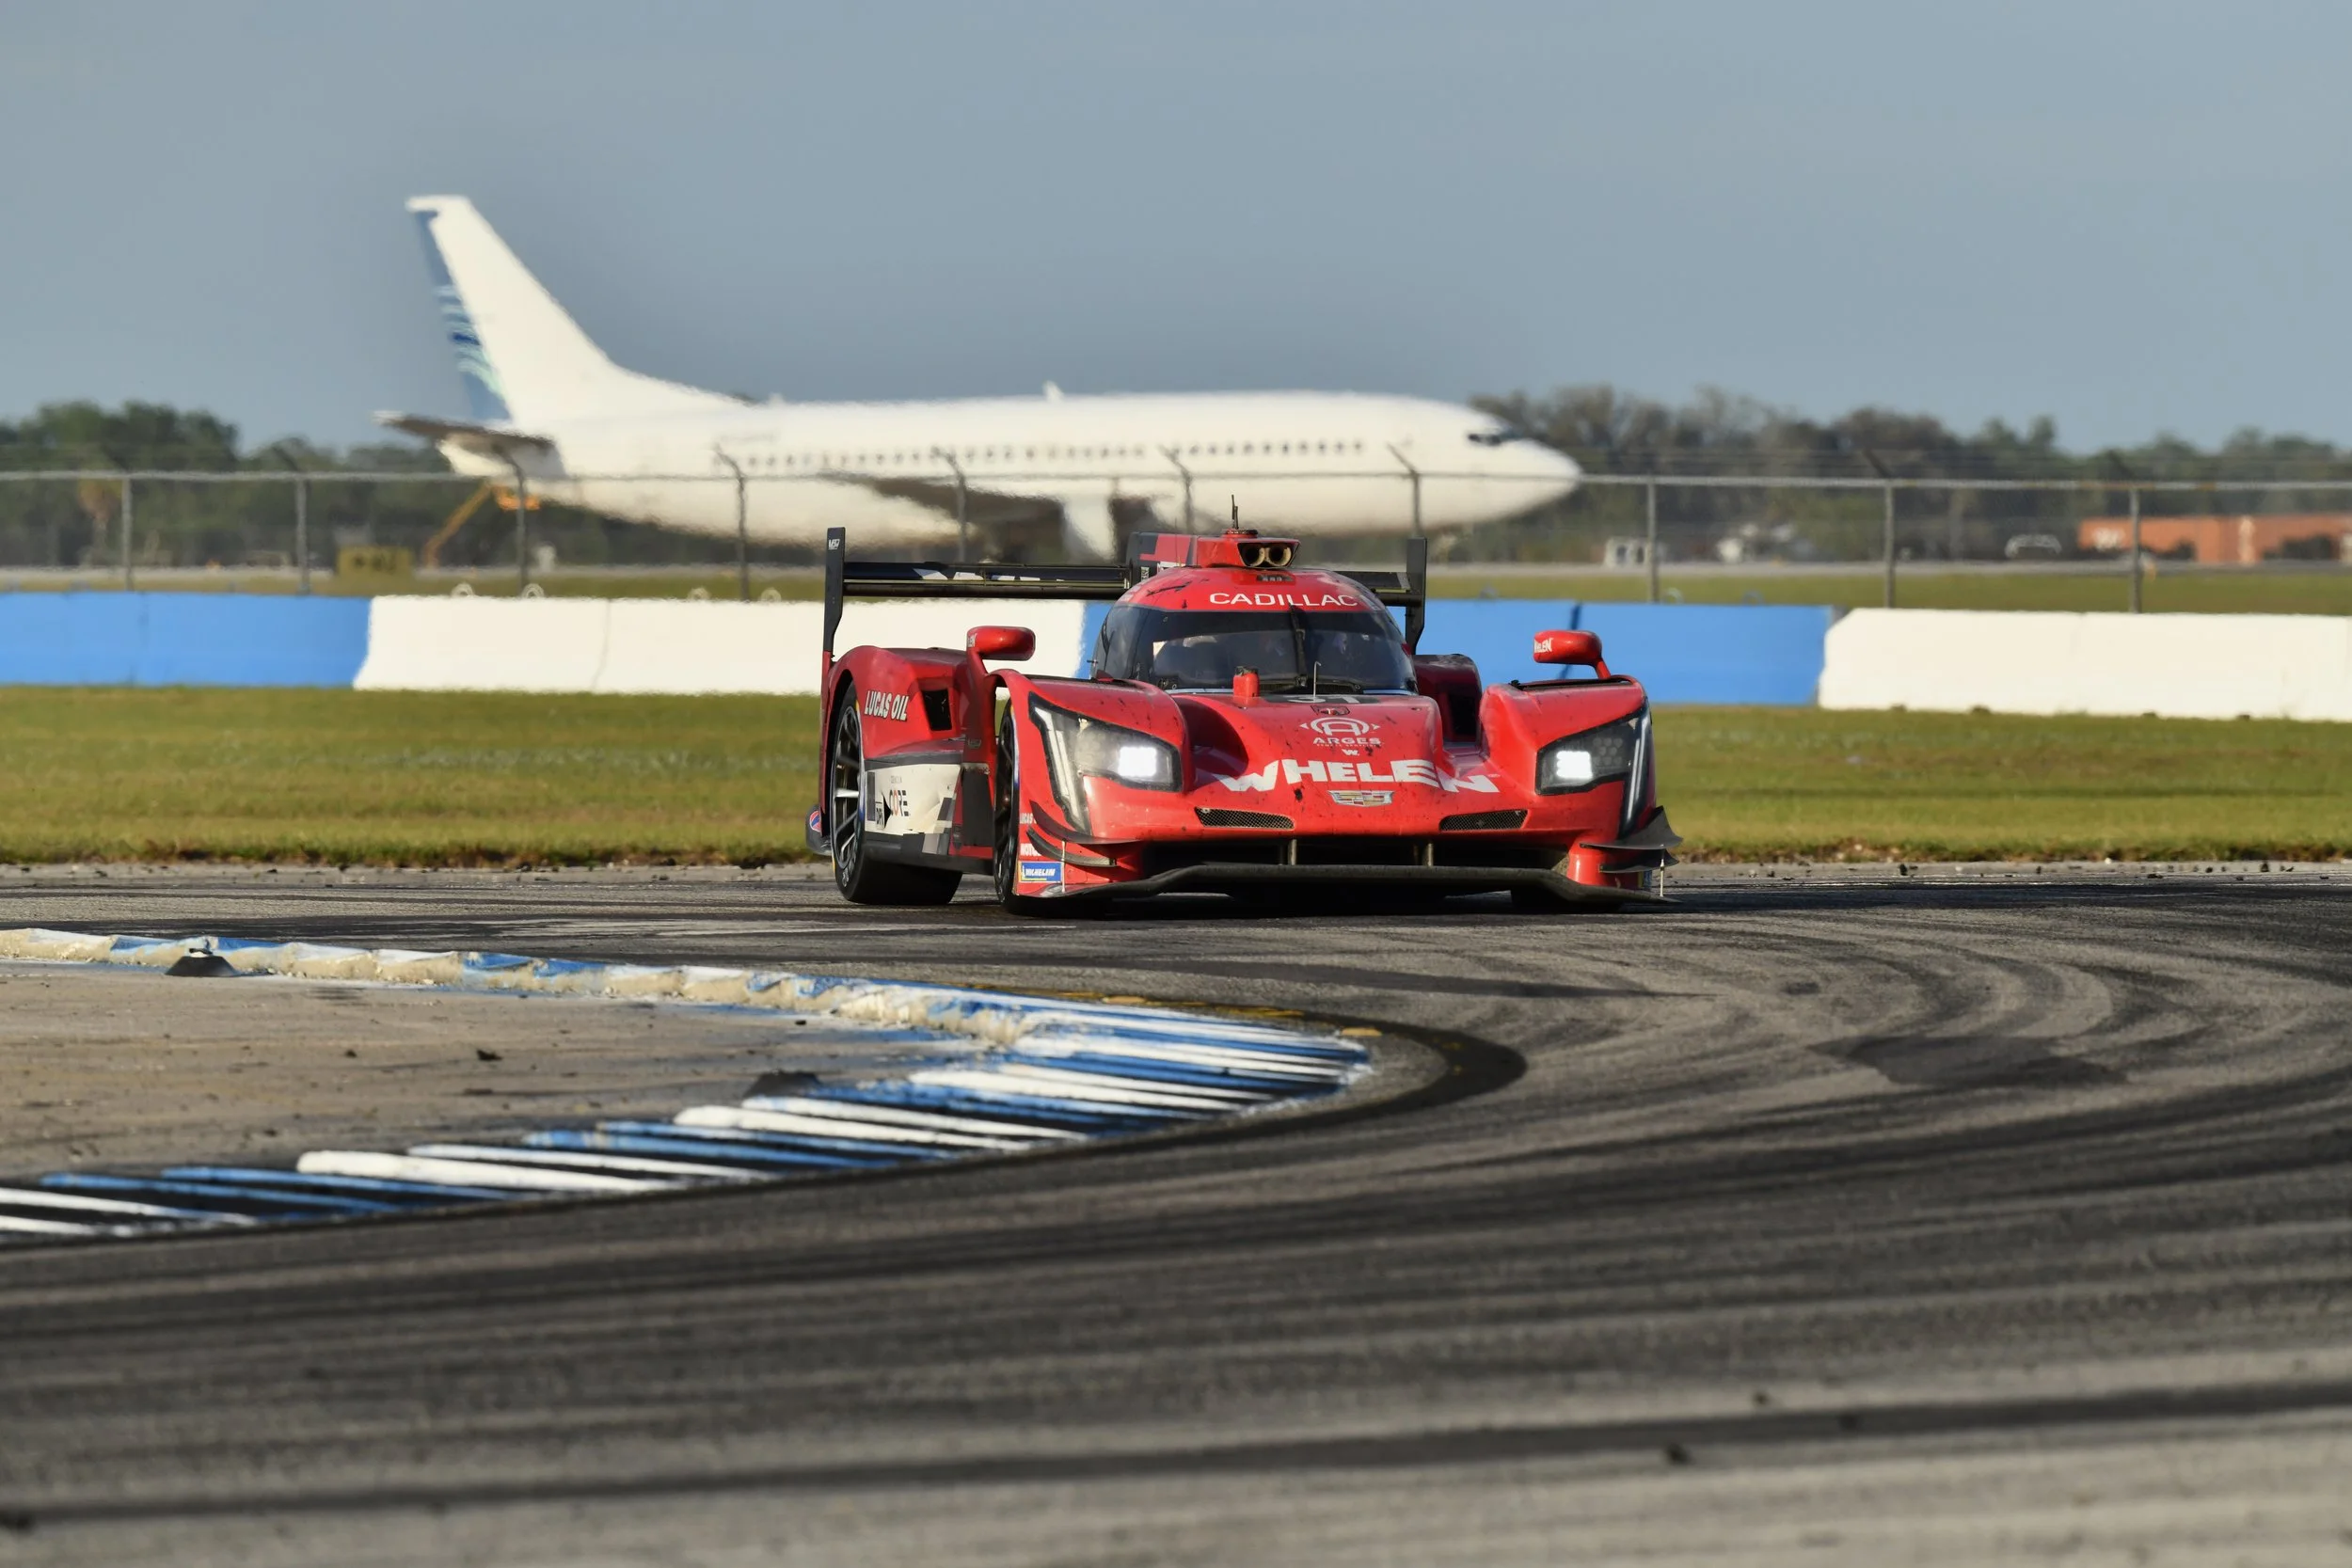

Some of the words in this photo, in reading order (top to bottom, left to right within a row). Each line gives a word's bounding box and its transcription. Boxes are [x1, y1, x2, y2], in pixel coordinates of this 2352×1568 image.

[1210, 593, 1358, 607] CADILLAC
[865, 690, 893, 719] LUCAS
[891, 694, 909, 721] OIL
[1211, 758, 1500, 793] WHELEN
[1025, 868, 1056, 877] MICHELIN
